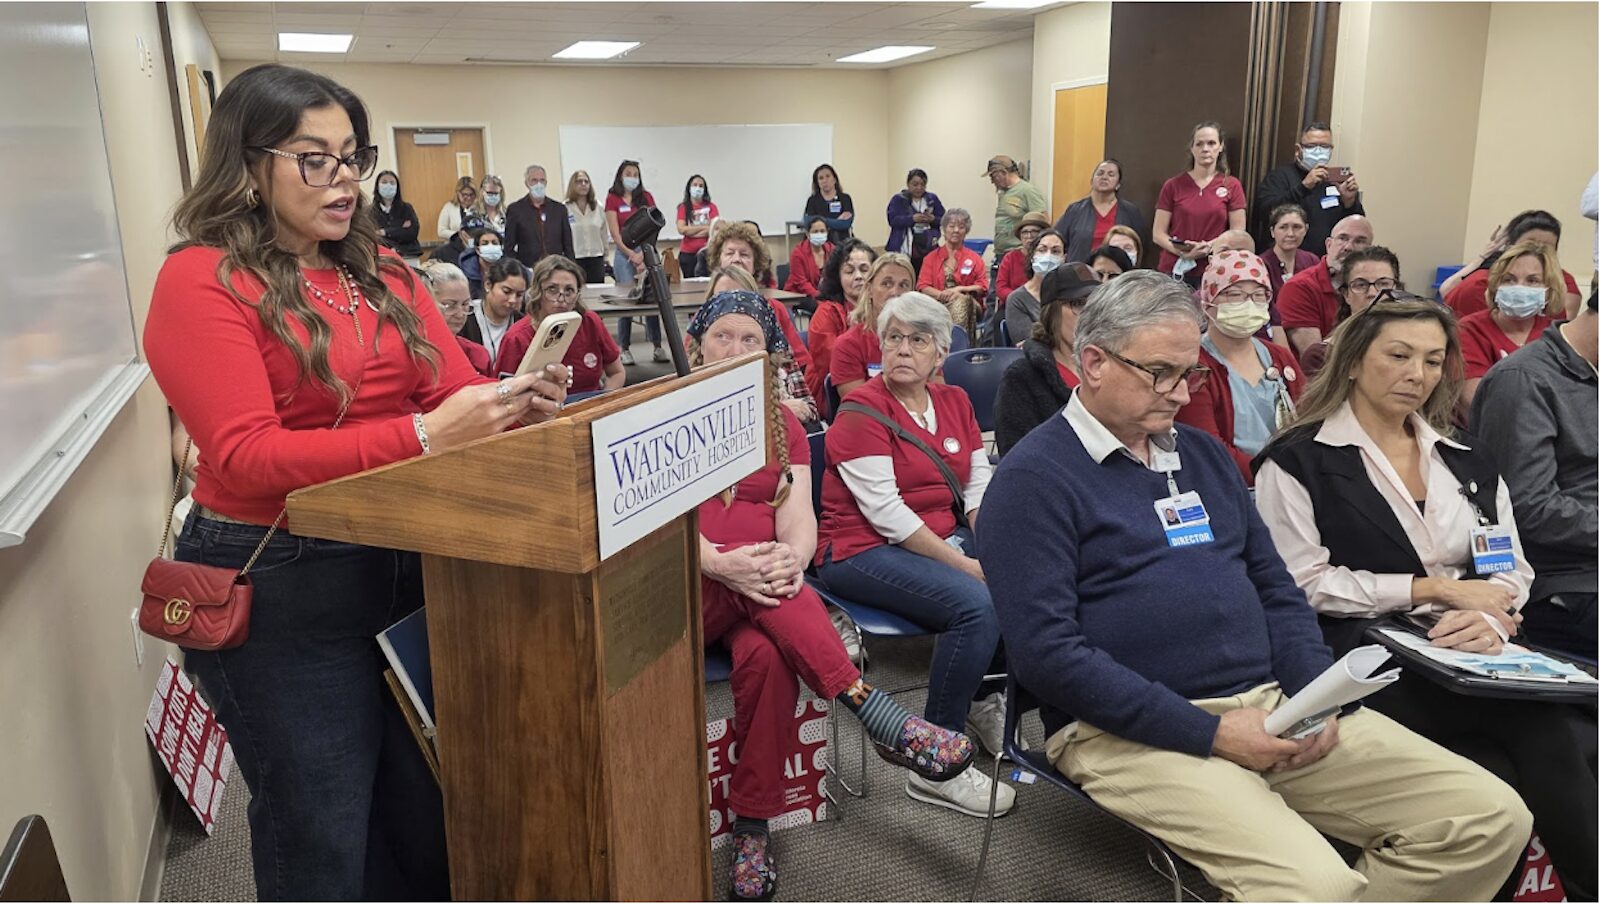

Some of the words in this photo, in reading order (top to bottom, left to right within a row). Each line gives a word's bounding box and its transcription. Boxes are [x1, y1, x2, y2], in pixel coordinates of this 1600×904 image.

[609, 395, 756, 490] WATSONVILLE
[613, 454, 701, 516] COMMUNITY
[707, 427, 757, 467] HOSPITAL
[1170, 532, 1211, 546] DIRECTOR
[1477, 561, 1514, 572] DIRECTOR
[168, 684, 188, 726] CUTS
[186, 702, 207, 746] HEAL
[160, 715, 180, 764] SOME
[783, 752, 809, 780] AL
[1518, 864, 1556, 897] AL
